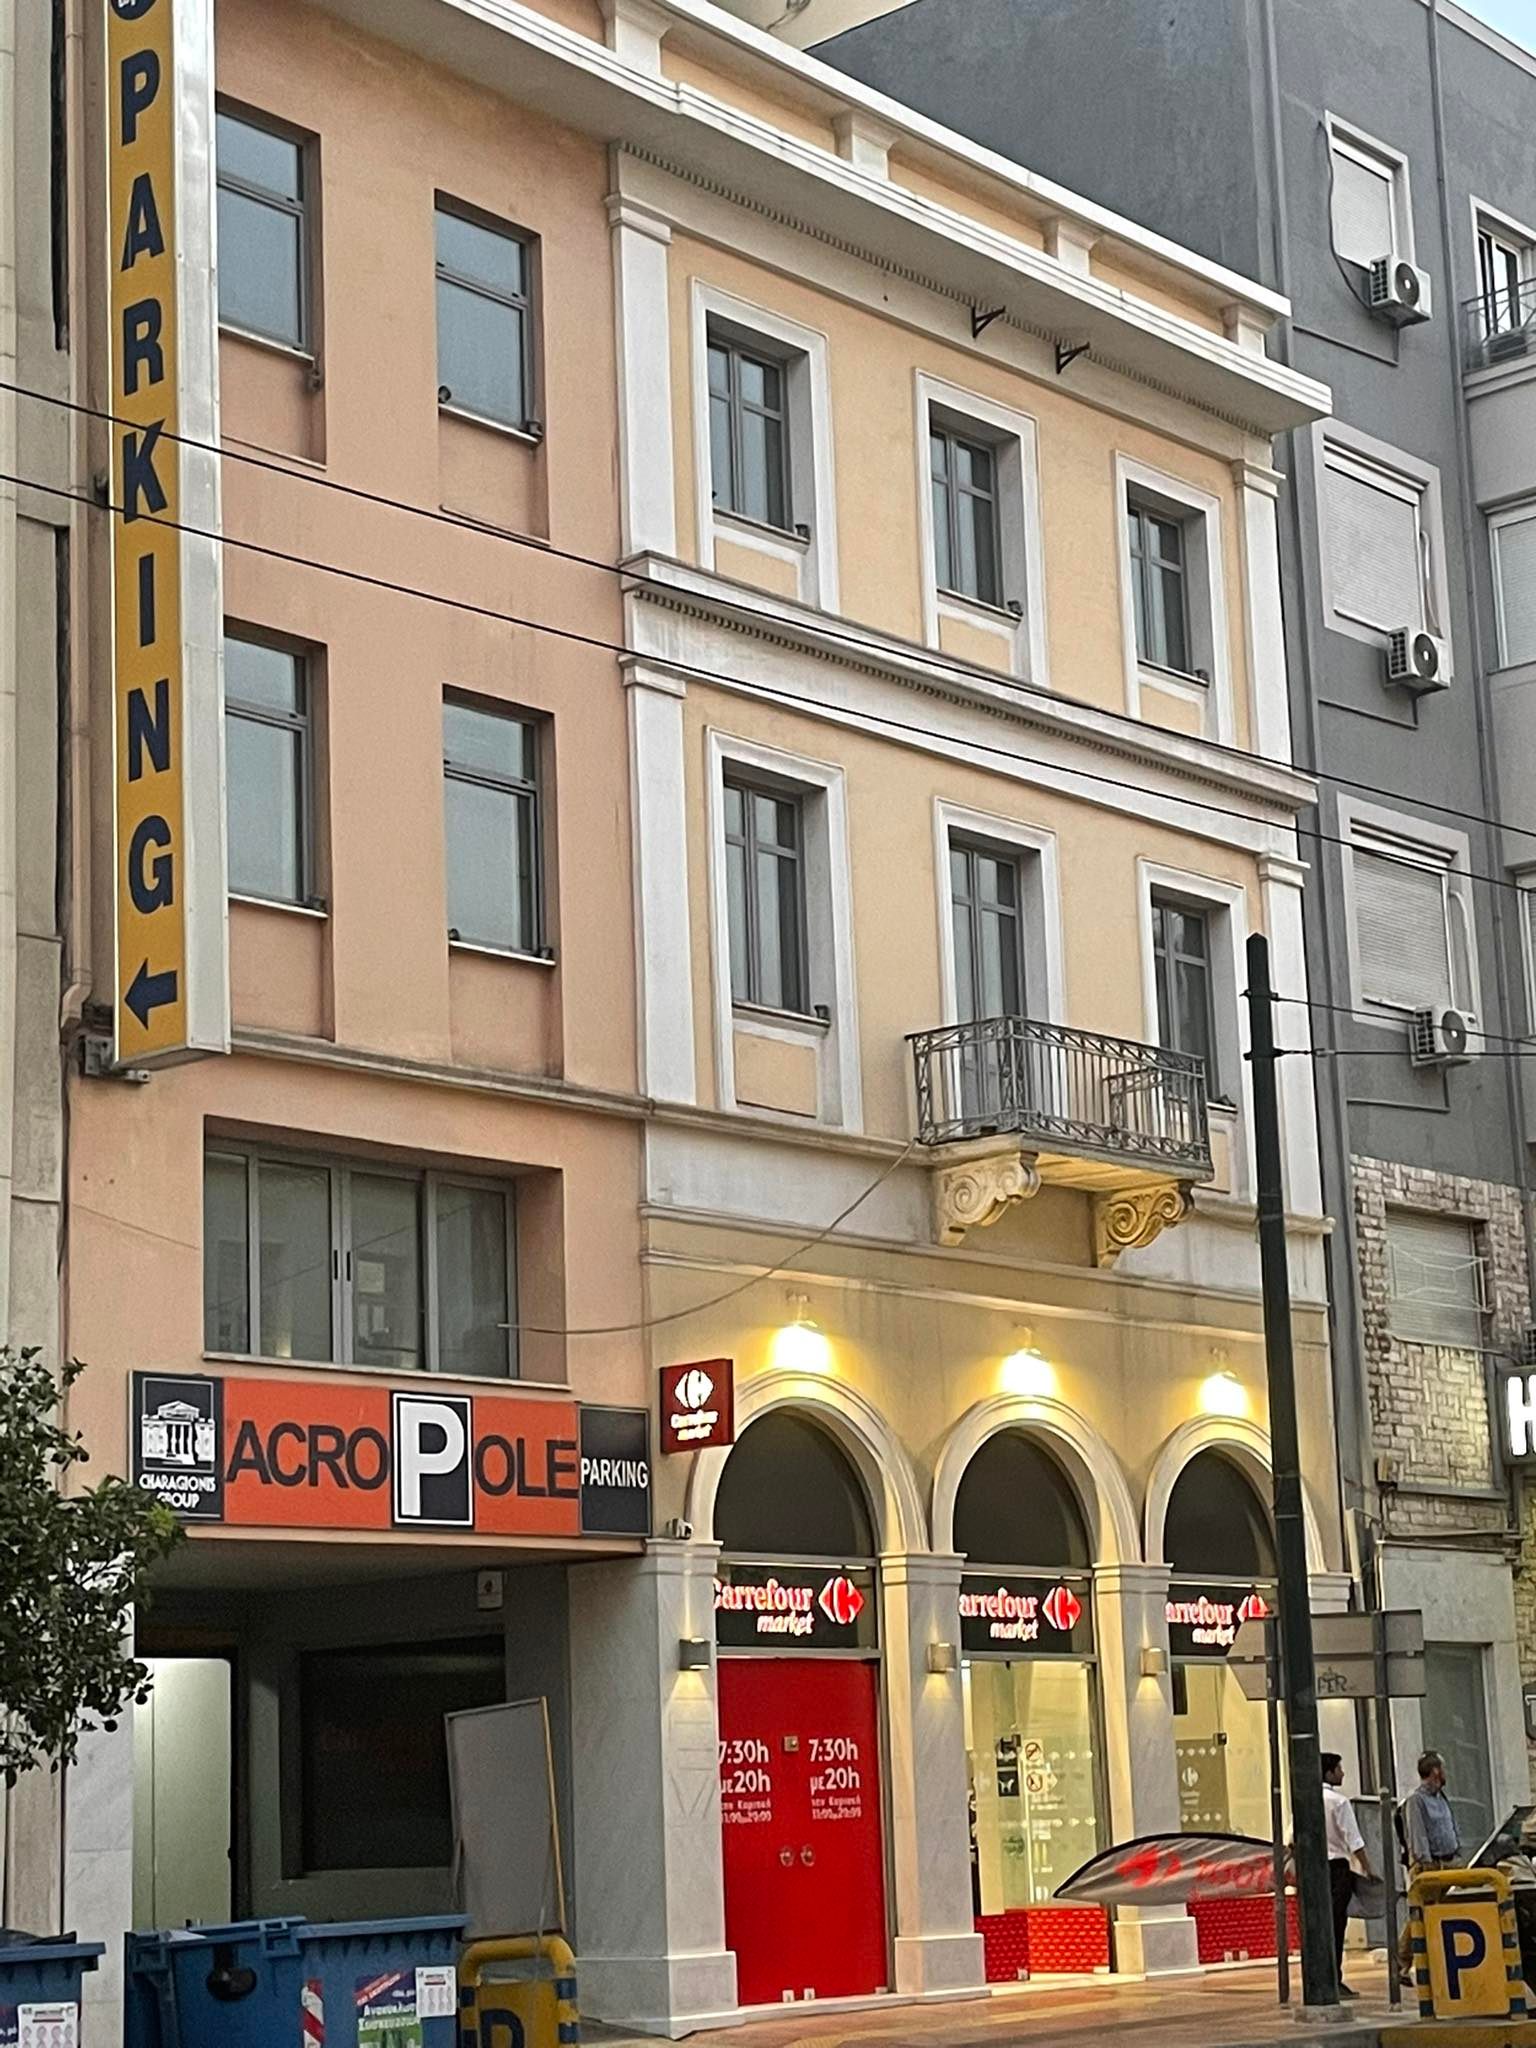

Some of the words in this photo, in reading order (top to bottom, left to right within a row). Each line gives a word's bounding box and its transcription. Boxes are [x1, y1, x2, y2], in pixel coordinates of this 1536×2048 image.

[120, 48, 175, 915] PARKING
[581, 1457, 649, 1489] PARKING
[756, 1610, 814, 1637] market
[989, 1618, 1040, 1642] market
[719, 1739, 770, 1764] 7:30h
[808, 1737, 859, 1762] 7:30h
[1441, 1919, 1486, 2000] P
